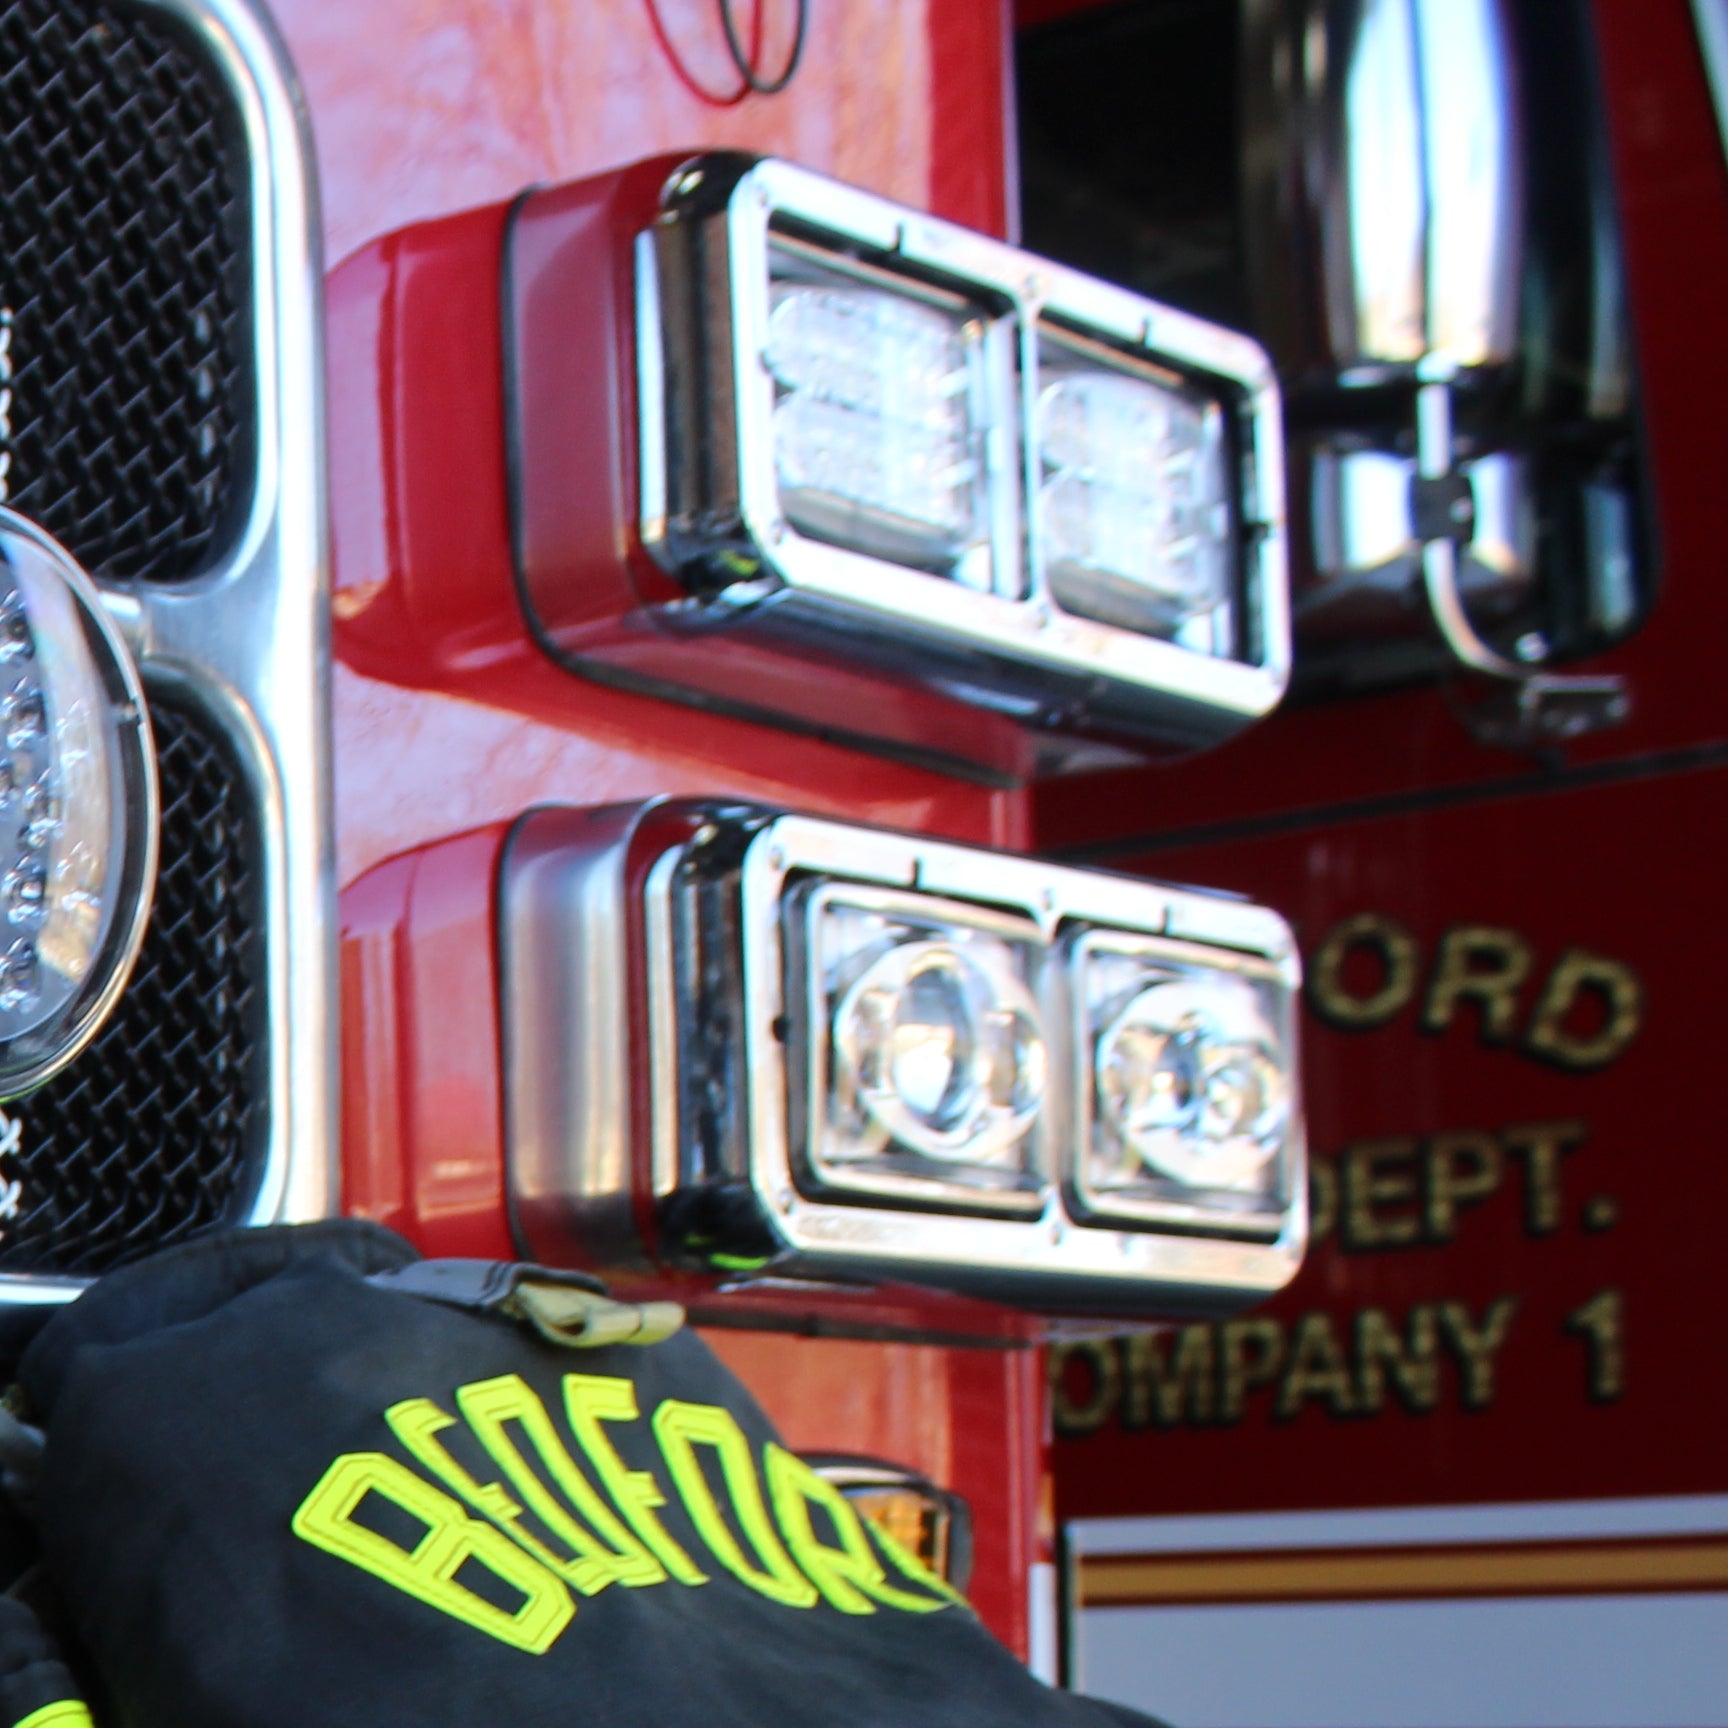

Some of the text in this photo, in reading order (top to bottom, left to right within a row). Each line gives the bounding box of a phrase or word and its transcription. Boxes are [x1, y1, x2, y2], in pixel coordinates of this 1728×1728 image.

[1312, 914, 1642, 1067] ORD
[1050, 1293, 1624, 1430] OMPANY 1
